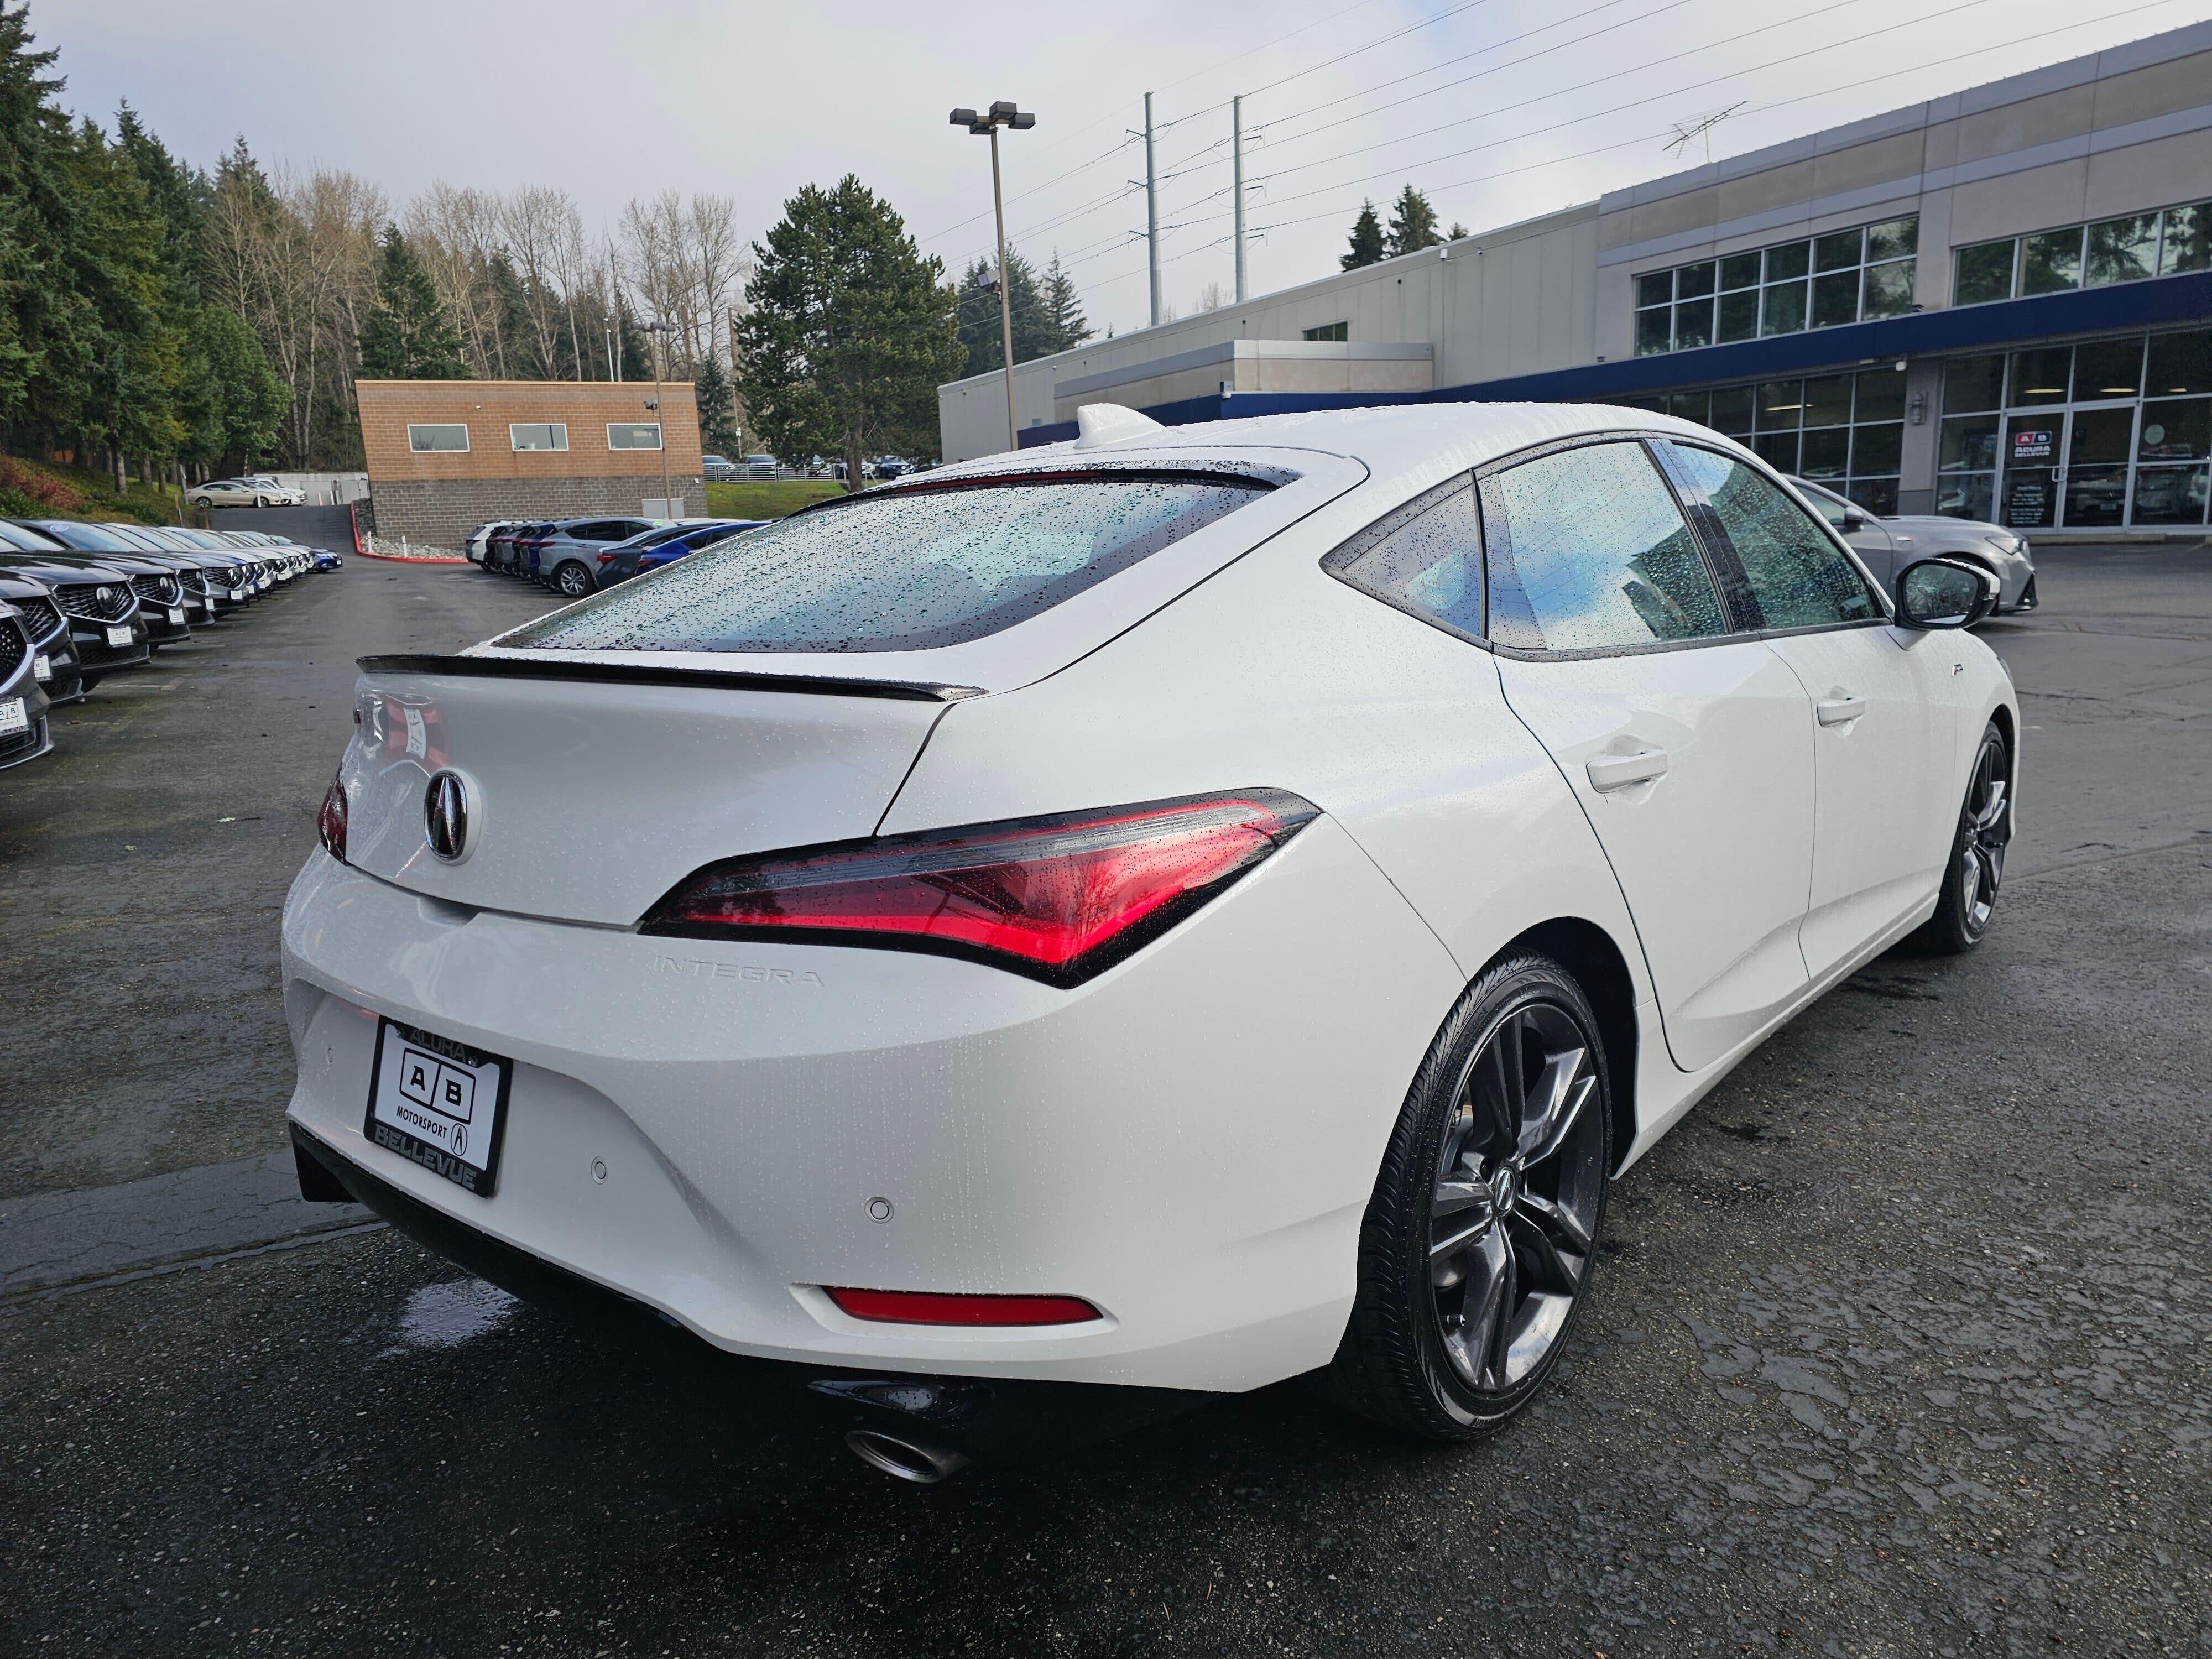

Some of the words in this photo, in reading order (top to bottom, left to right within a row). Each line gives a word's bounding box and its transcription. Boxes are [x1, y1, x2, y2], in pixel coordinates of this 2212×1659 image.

[653, 955, 826, 988] INTEGRA
[410, 1065, 425, 1091] A
[445, 1079, 462, 1106] B
[396, 1105, 447, 1139] MOTORSPORT
[374, 1125, 477, 1190] BELLEVUE
